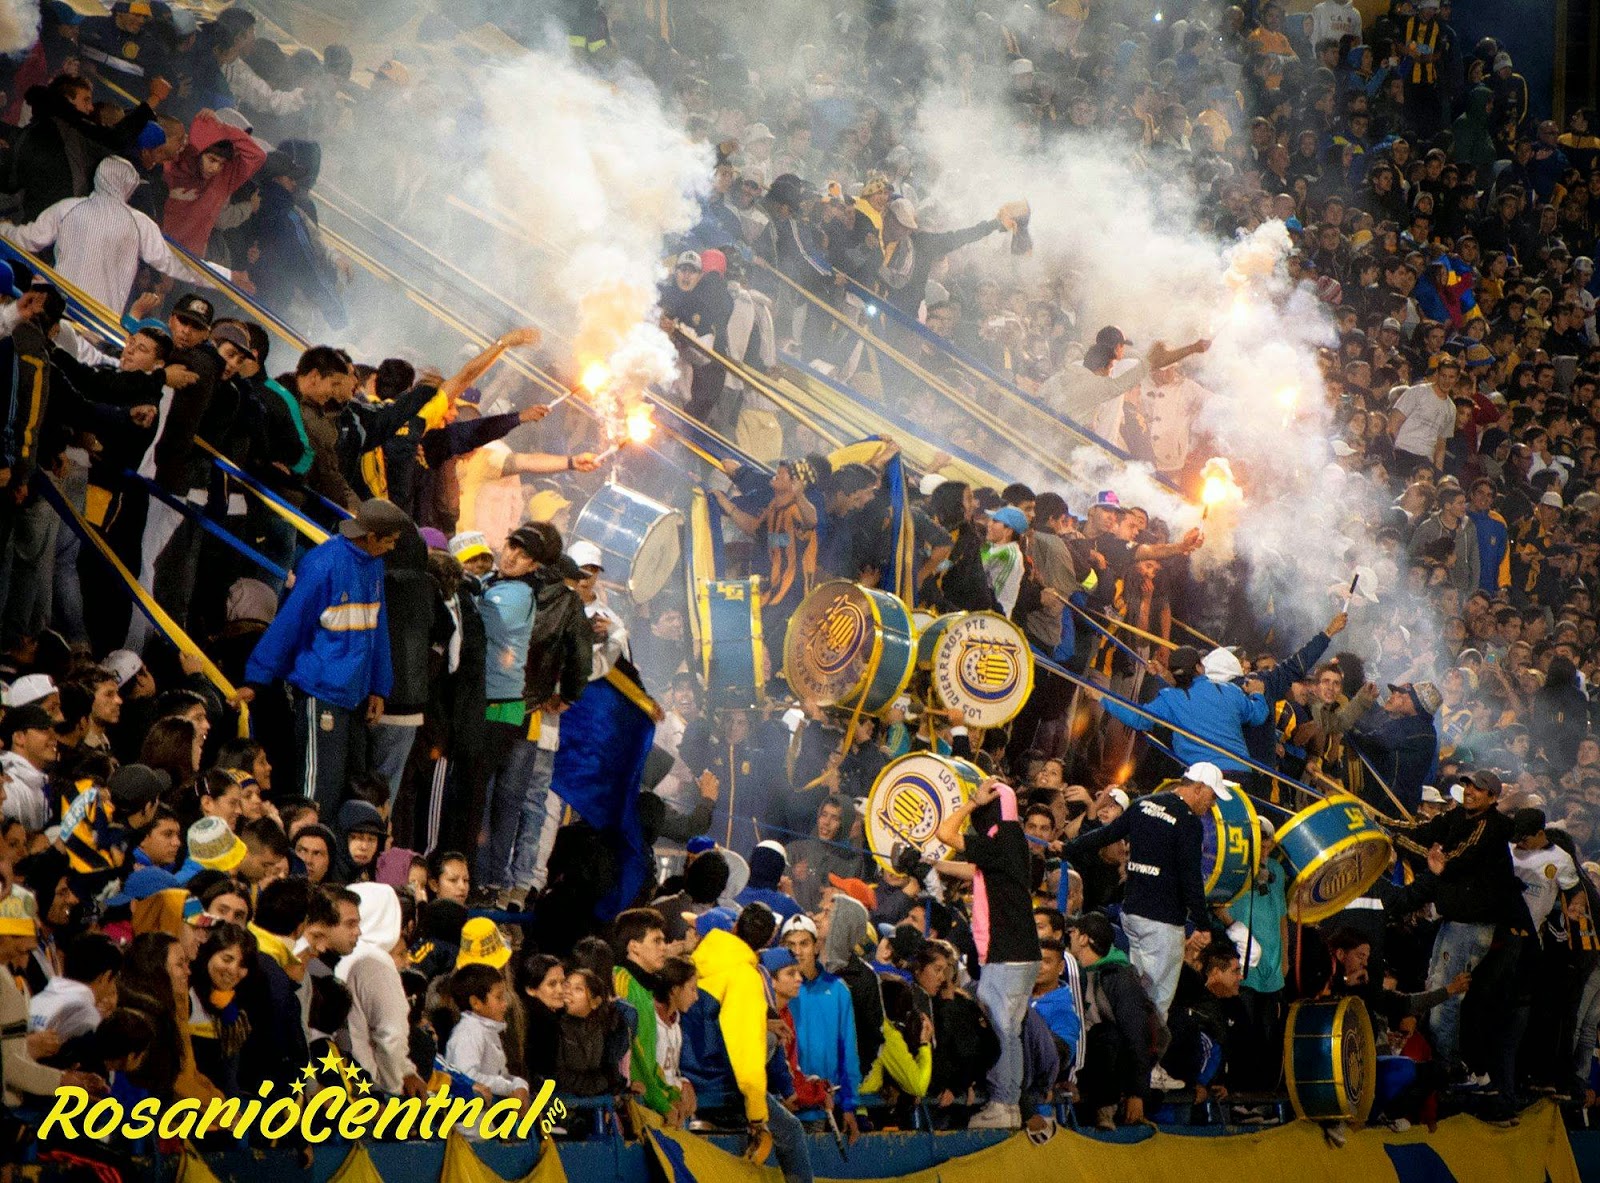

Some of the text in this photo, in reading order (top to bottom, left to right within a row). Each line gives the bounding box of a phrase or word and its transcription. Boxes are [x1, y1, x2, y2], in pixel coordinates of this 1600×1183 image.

[940, 629, 963, 706] GUERREROS
[962, 704, 982, 720] LOS
[938, 769, 956, 792] LOS
